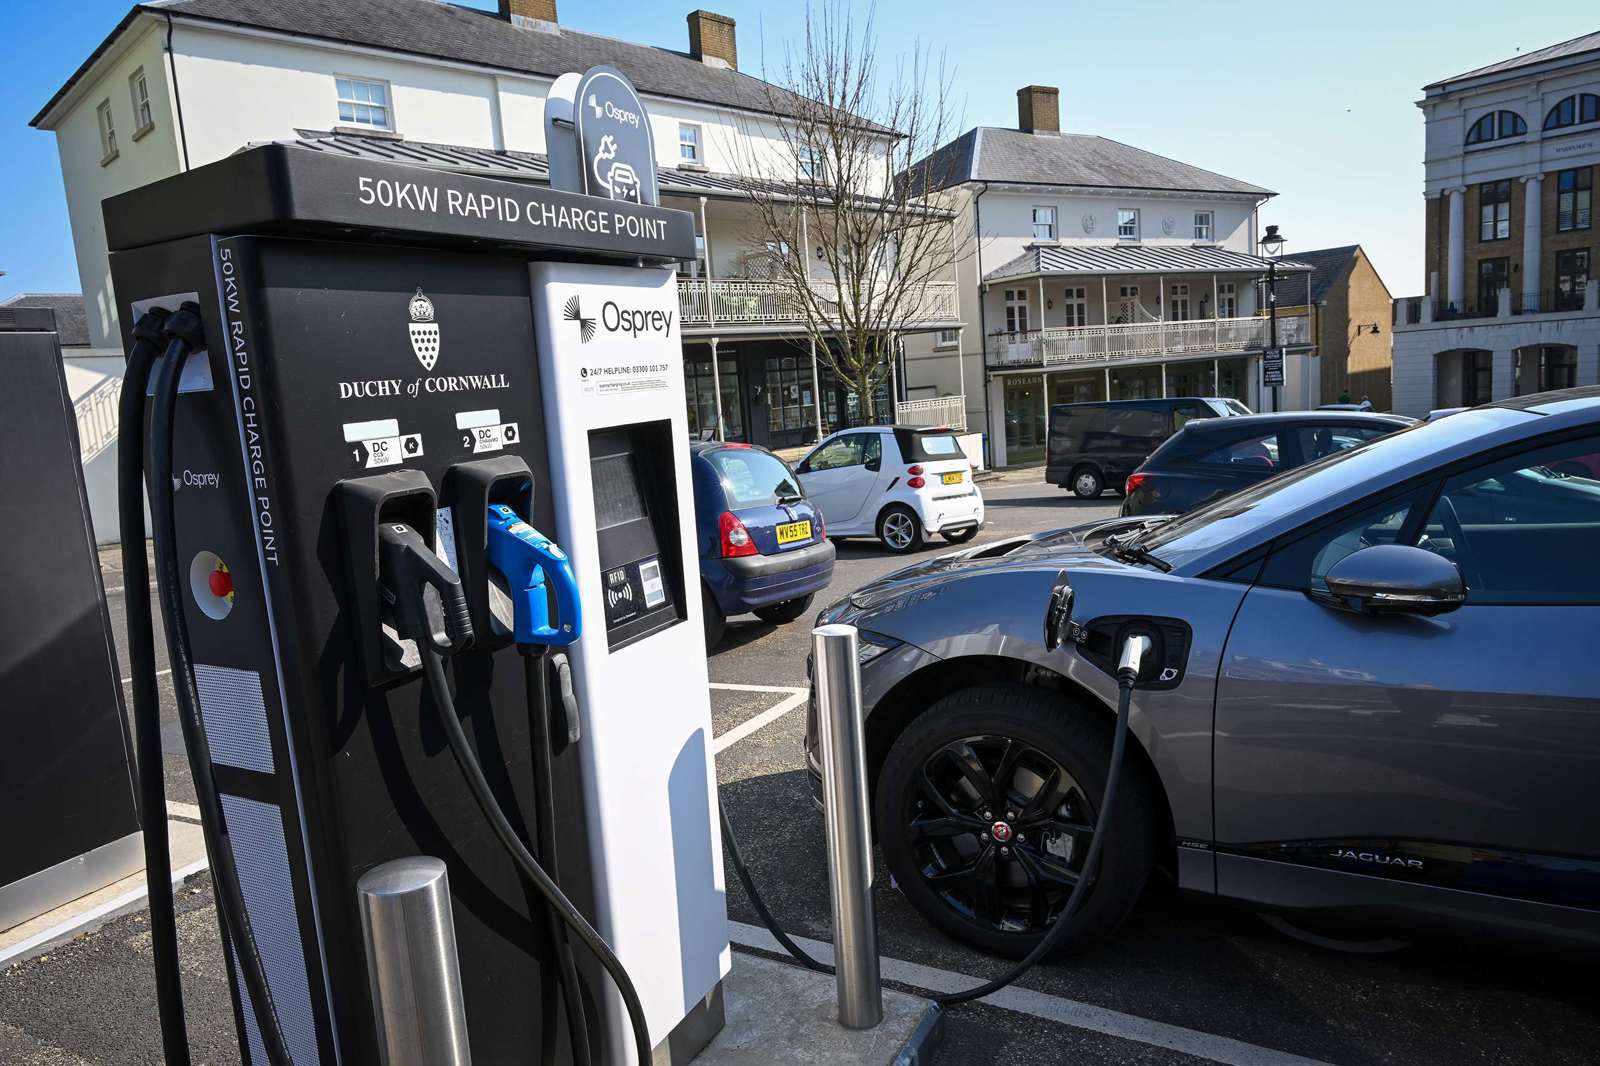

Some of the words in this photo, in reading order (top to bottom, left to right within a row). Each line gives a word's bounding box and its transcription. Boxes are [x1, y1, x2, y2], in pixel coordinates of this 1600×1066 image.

[605, 101, 640, 128] Osprey
[358, 177, 438, 213] 50KW
[447, 189, 520, 222] RAPID
[526, 202, 610, 235] CHARGE
[615, 214, 667, 241] POINT
[602, 301, 672, 338] Osprey
[590, 368, 602, 376] 24/7
[604, 366, 631, 375] HELPLINE:
[649, 364, 658, 372] 101
[339, 380, 402, 398] DUCHY
[407, 378, 421, 397] of
[425, 374, 510, 393] CORNWALL
[220, 248, 241, 313] 50KW
[231, 320, 251, 390] RAPID
[243, 396, 267, 489] CHARGE
[257, 496, 279, 567] POINT
[463, 436, 470, 447] 2
[478, 429, 491, 439] DC
[352, 449, 360, 462] 1
[372, 441, 388, 452] DC
[183, 470, 220, 488] Osprey
[609, 570, 625, 585] RFID
[1330, 849, 1424, 869] JAGUAR
